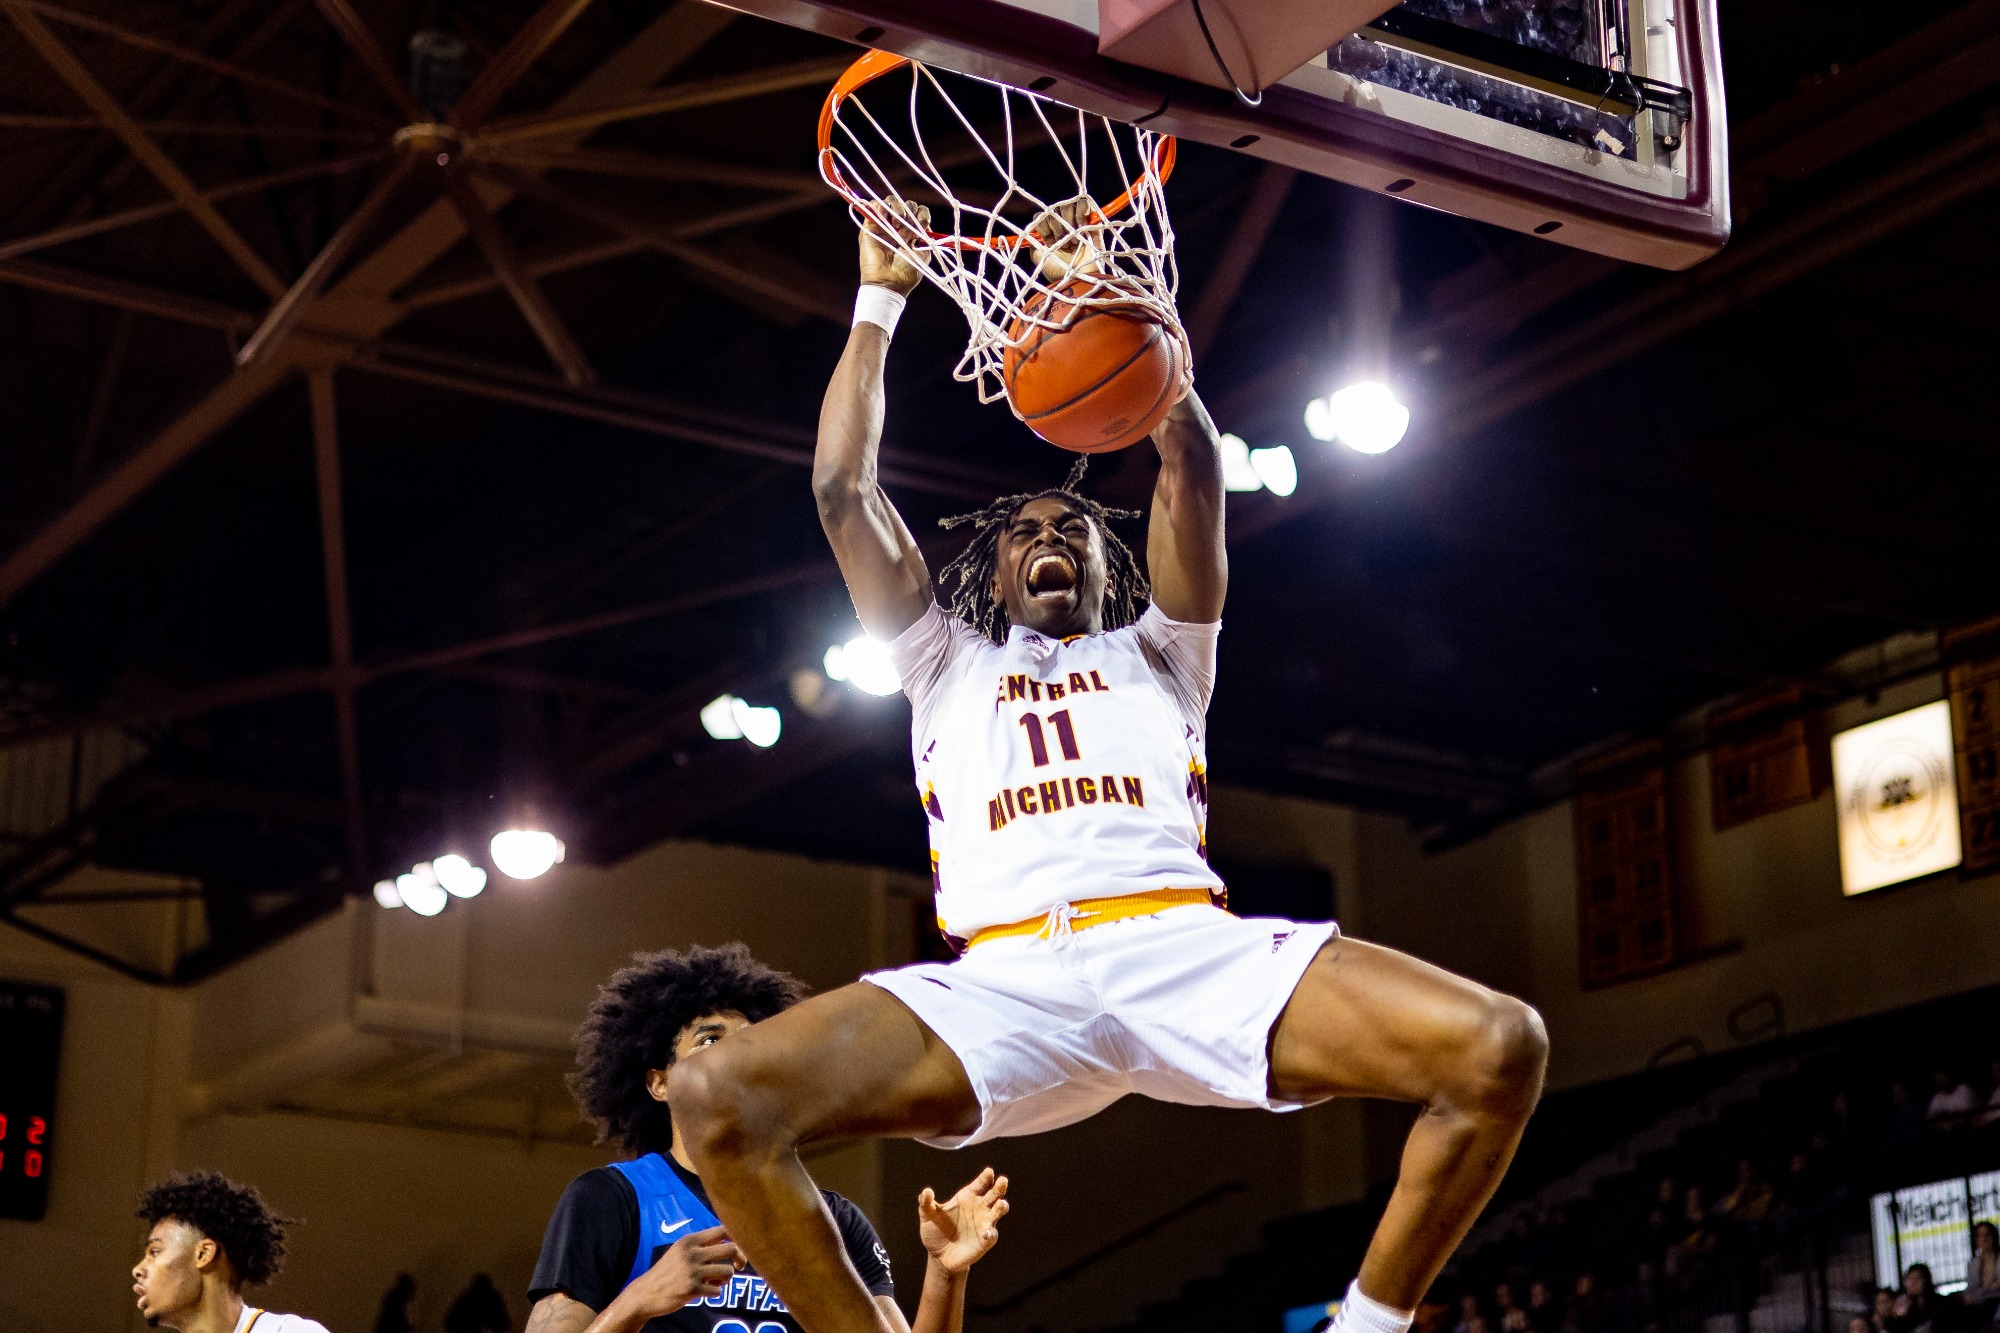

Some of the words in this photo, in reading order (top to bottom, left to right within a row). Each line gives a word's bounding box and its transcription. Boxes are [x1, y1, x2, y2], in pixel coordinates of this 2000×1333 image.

[997, 669, 1110, 702] ENTRAL
[1019, 709, 1081, 768] 11
[988, 775, 1145, 831] MICHIGAN
[684, 1274, 790, 1312] UFFA
